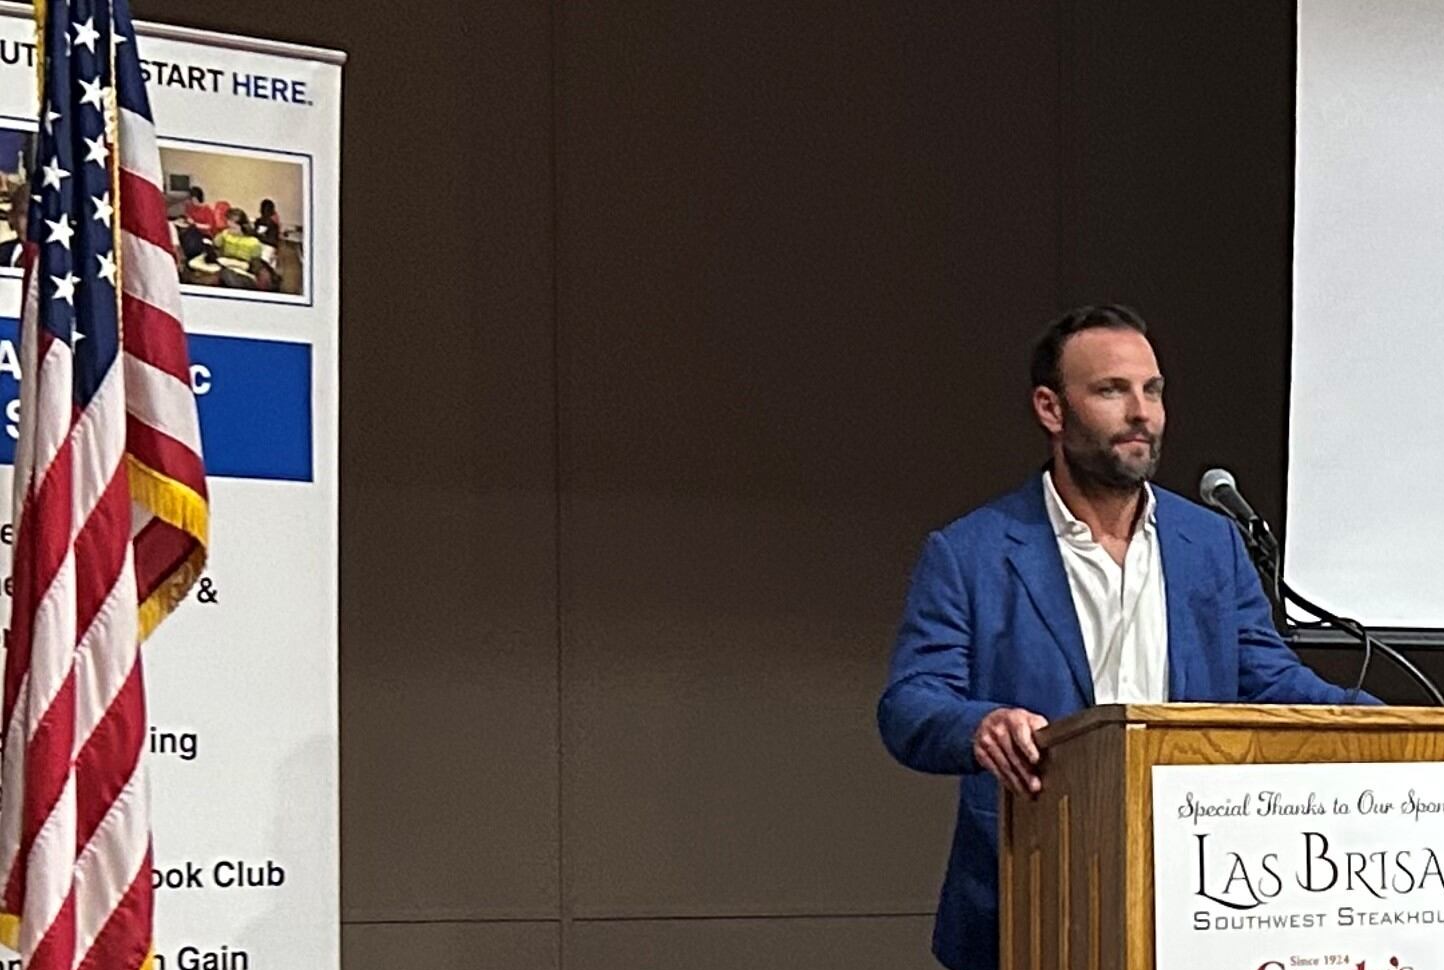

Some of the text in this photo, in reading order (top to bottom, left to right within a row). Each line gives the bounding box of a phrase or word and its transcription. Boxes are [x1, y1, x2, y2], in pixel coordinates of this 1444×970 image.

[140, 60, 314, 106] START HERE.
[150, 726, 197, 761] ing
[1178, 792, 1251, 825] Special
[1256, 790, 1327, 817] Thanks
[1333, 797, 1351, 815] to
[1357, 789, 1395, 815] Our
[151, 860, 285, 890] ook Club
[1193, 833, 1283, 910] LAS
[1193, 910, 1327, 931] SOUTHWEST
[1290, 955, 1349, 966] Since 1924
